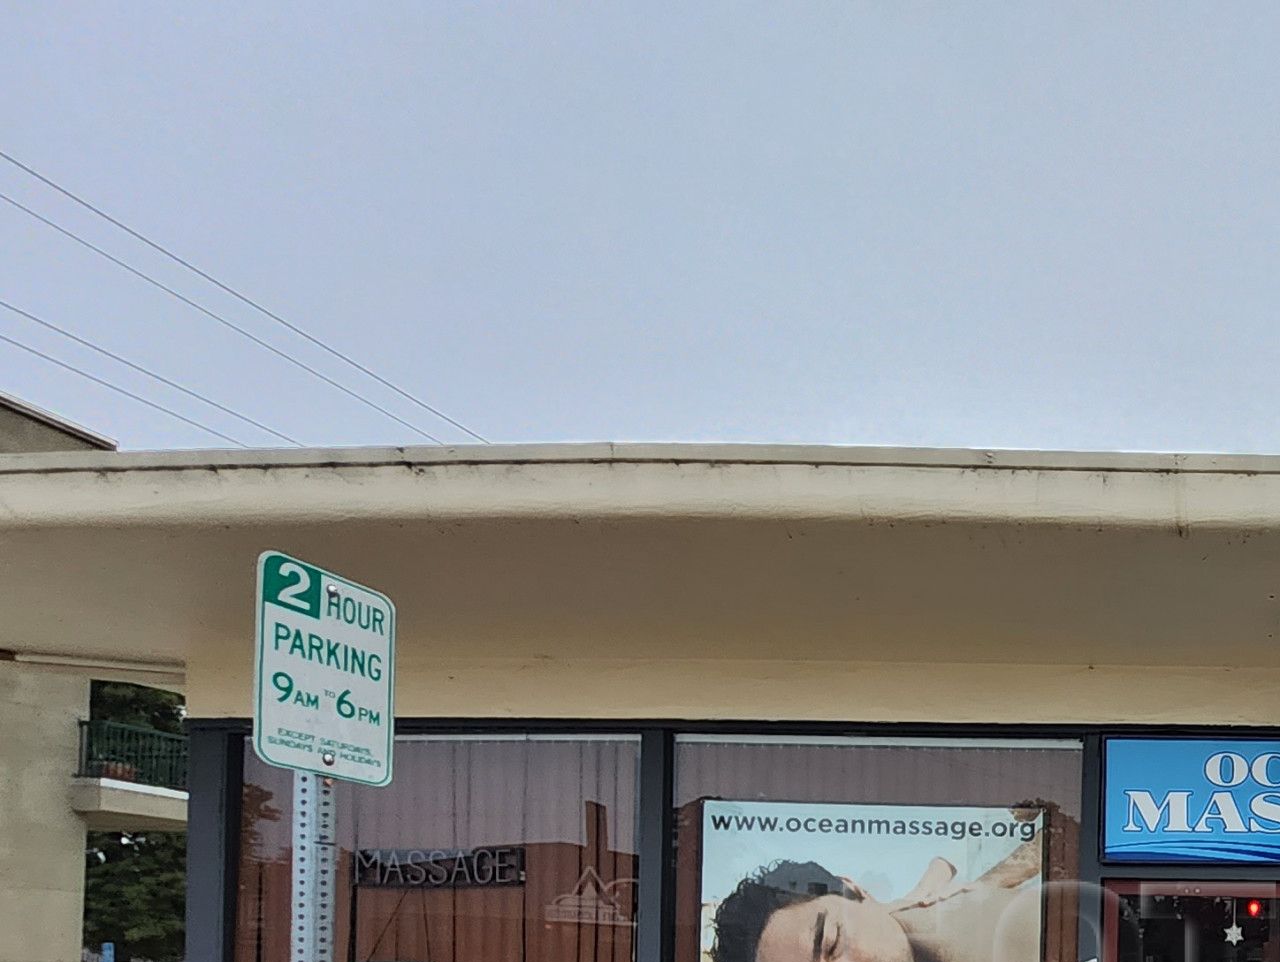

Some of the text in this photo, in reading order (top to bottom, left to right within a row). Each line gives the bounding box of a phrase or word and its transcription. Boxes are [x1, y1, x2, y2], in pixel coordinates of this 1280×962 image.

[277, 562, 385, 636] 2 HOUR
[273, 621, 382, 682] PARKING
[711, 814, 1037, 843] www.oceanmassage.org
[353, 849, 514, 885] MASSAGE
